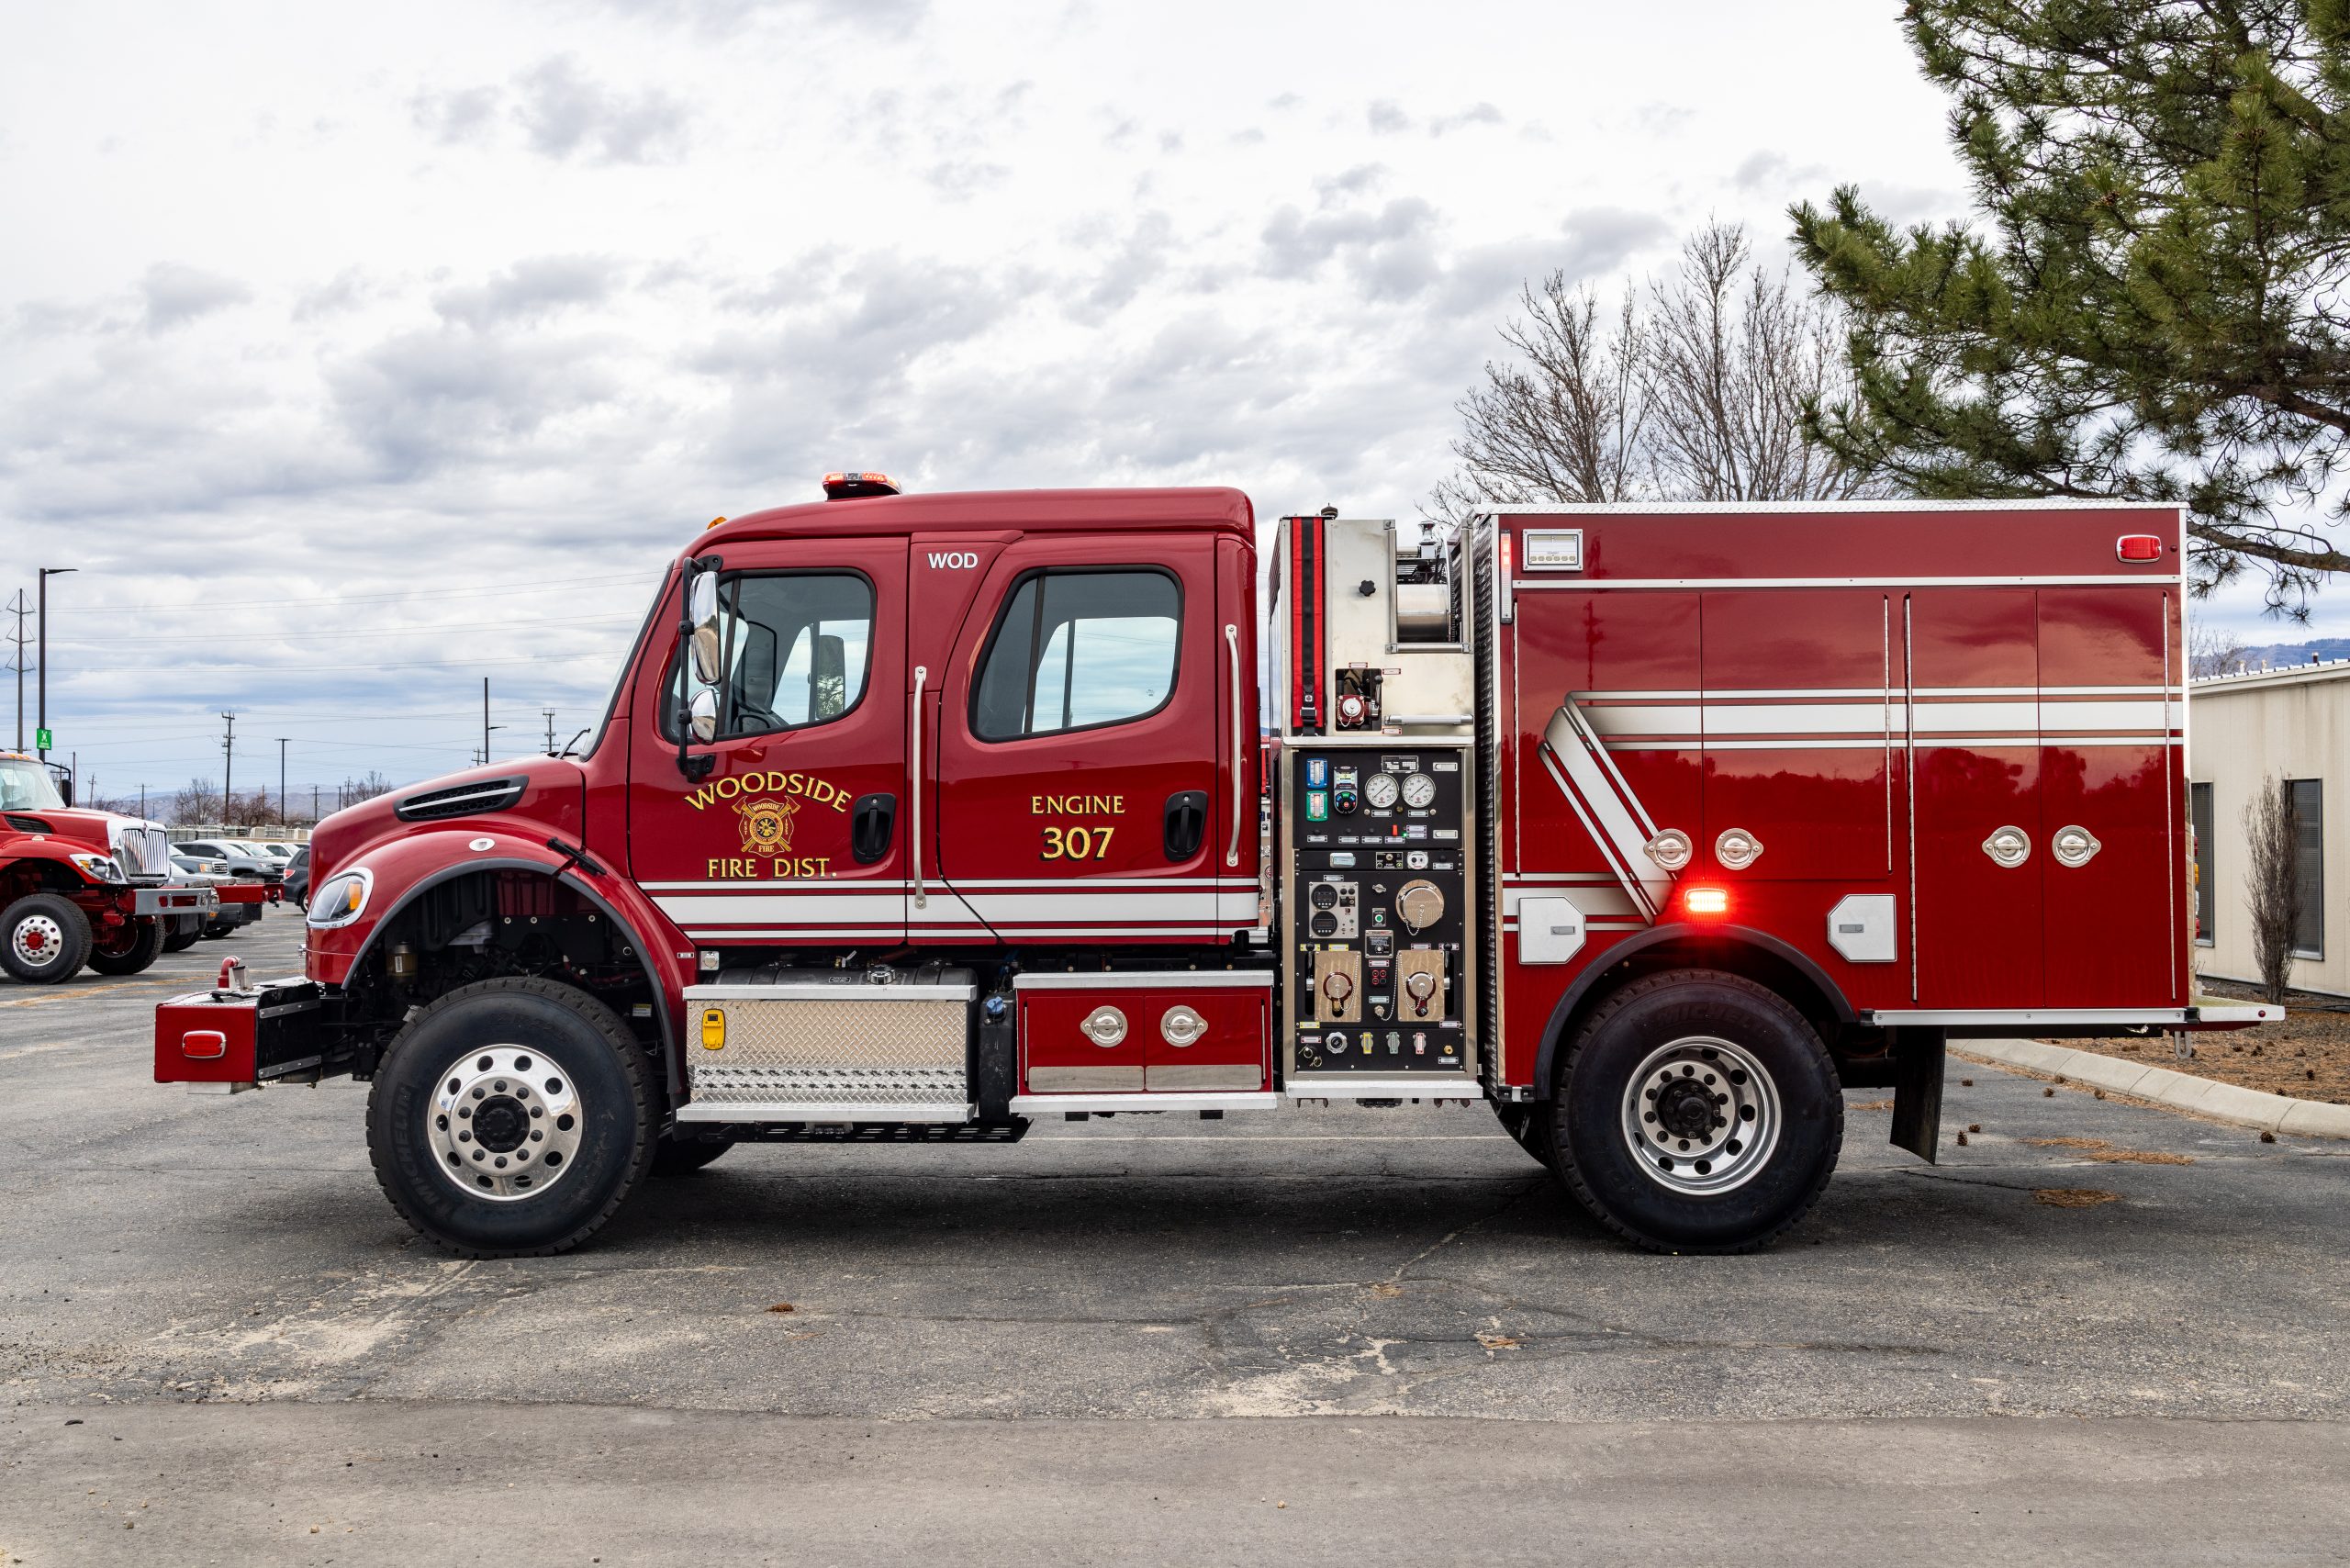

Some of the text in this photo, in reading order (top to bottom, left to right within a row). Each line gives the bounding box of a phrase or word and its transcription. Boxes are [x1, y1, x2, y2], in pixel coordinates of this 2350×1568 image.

[928, 553, 979, 569] WOD
[684, 771, 853, 813] WOODSIDE
[752, 802, 780, 812] WOODSIDE
[1031, 795, 1125, 815] ENGINE
[1040, 826, 1115, 861] 307
[708, 858, 837, 878] FIRE DIST.
